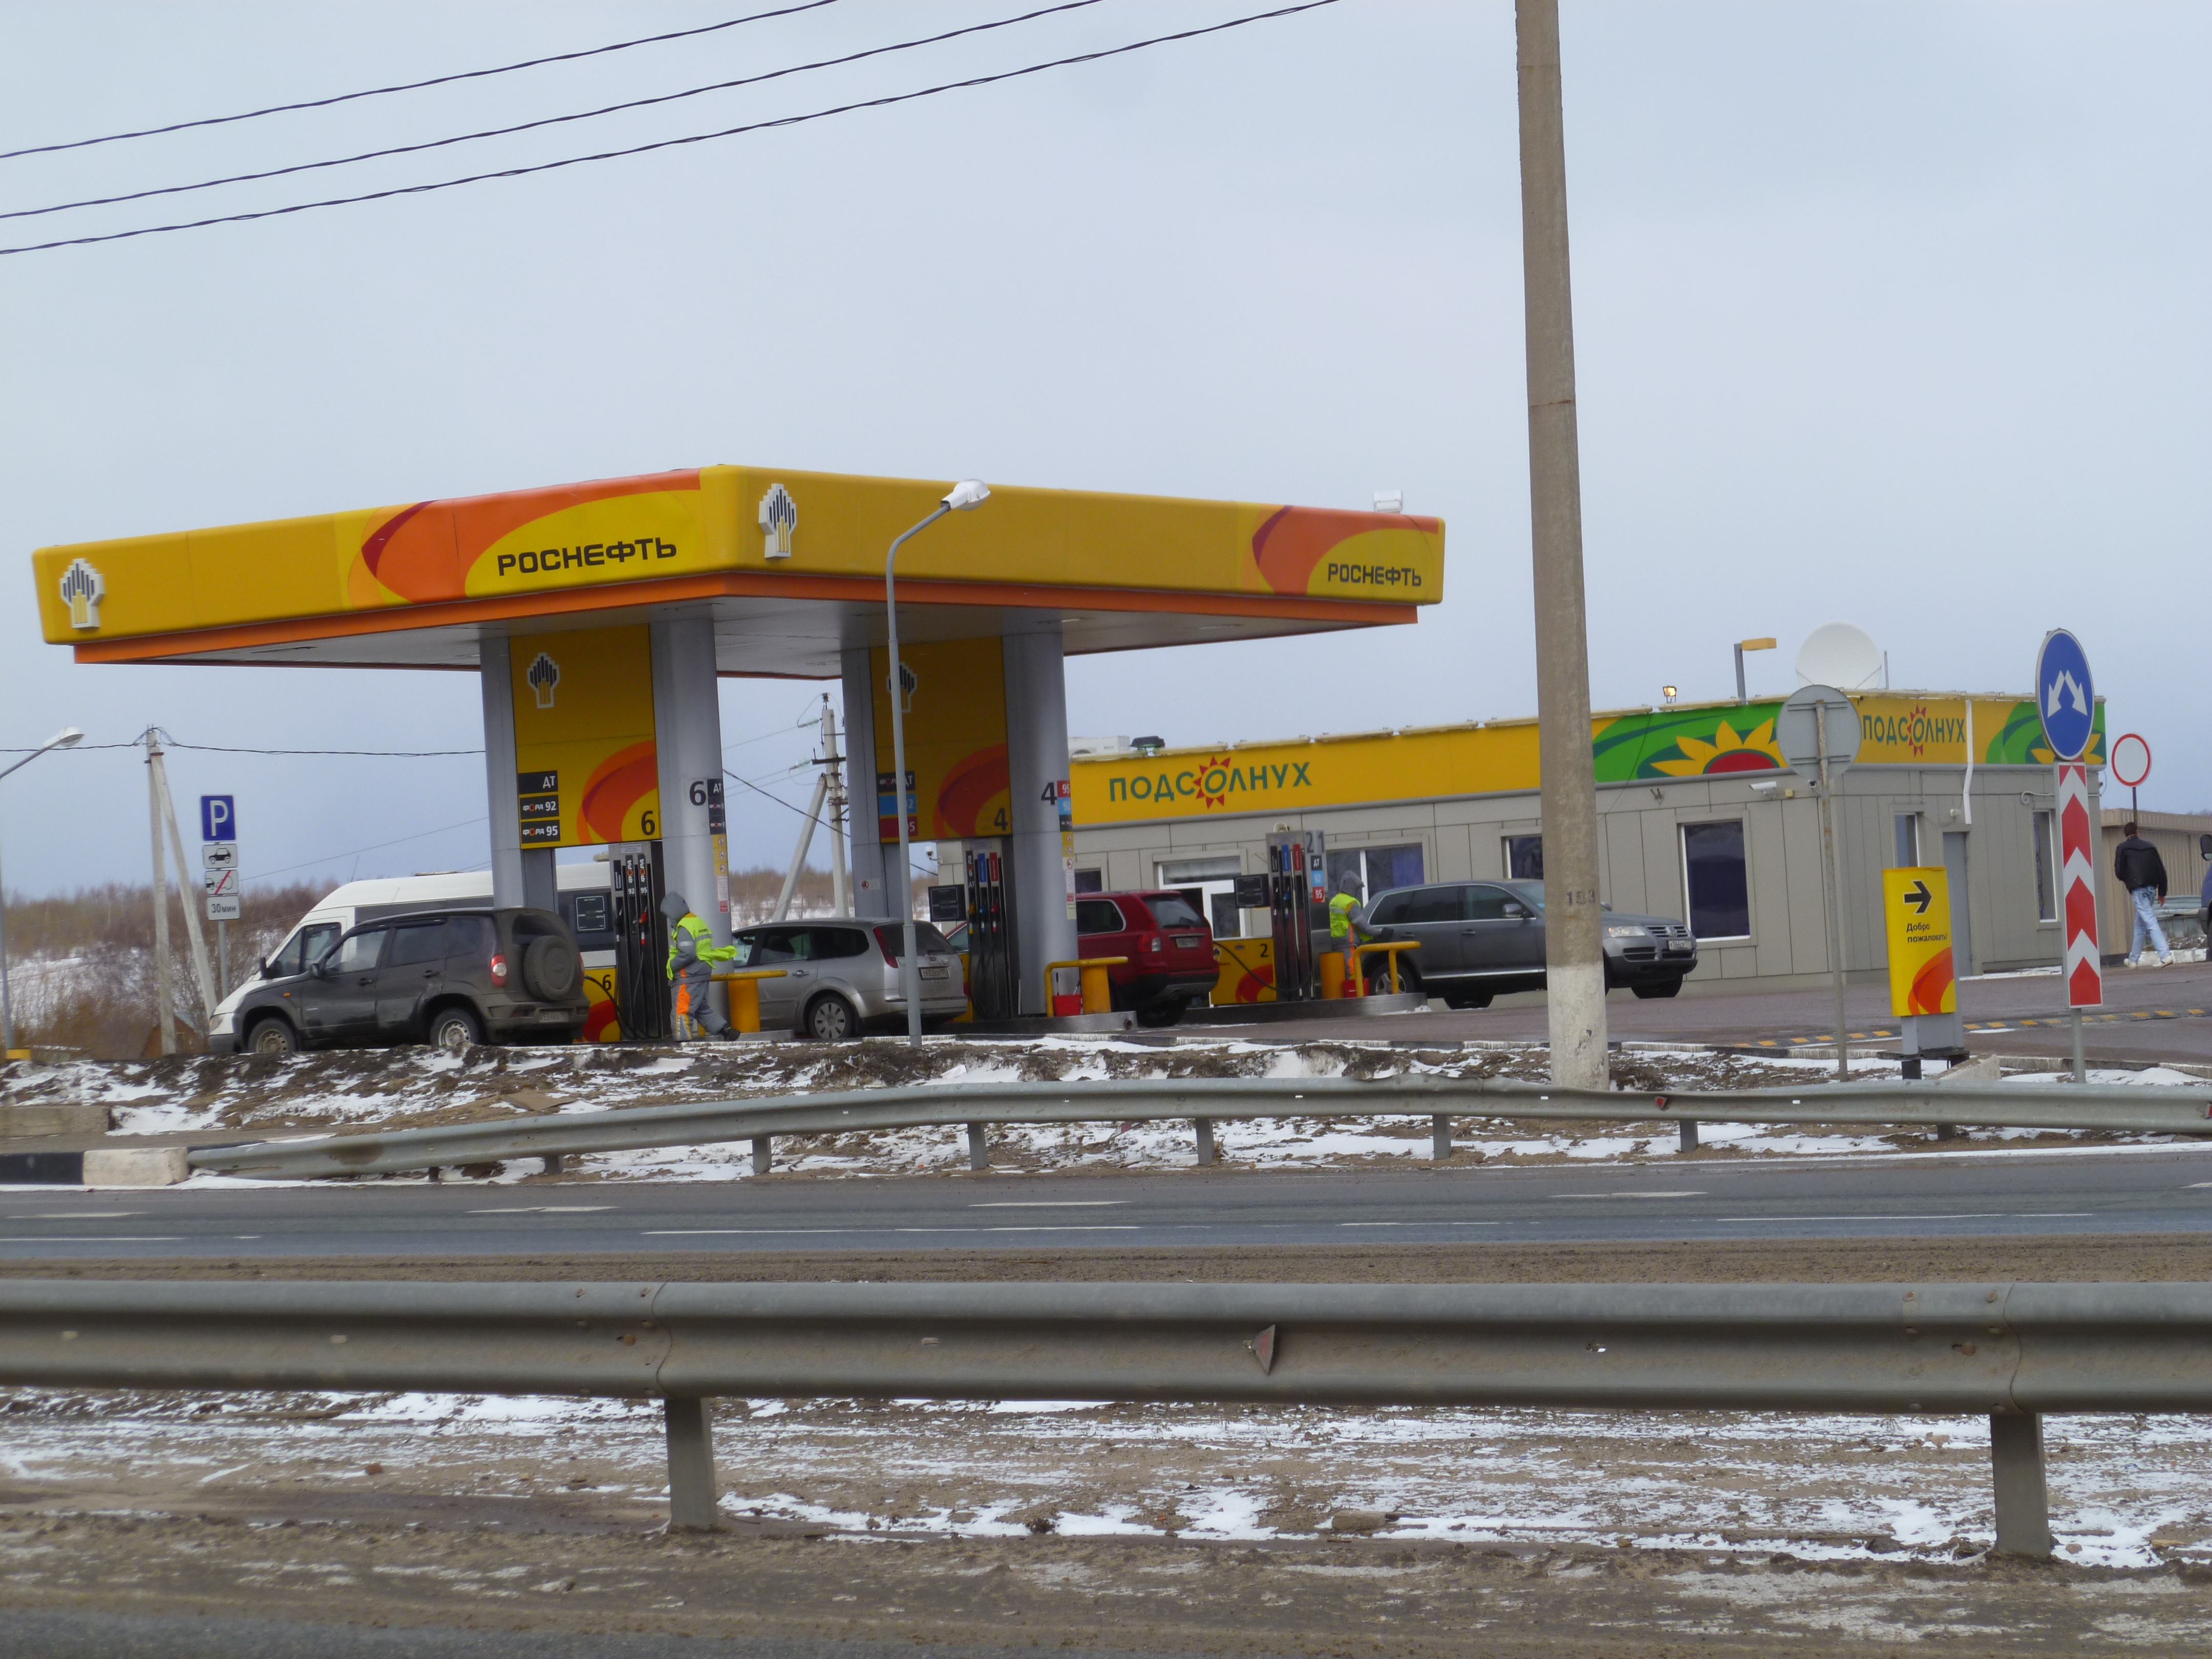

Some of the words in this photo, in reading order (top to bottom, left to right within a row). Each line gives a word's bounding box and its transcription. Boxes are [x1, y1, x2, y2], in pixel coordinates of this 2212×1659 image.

[497, 537, 677, 576] РОСНЕФТЬ
[1328, 563, 1422, 586] РОСНЕФТЬ
[1863, 715, 1966, 745] ПОДСОЛНУХ
[543, 775, 555, 789] ДТ
[879, 778, 897, 786] ФОР
[1062, 783, 1070, 794] 95
[1110, 761, 1312, 802] ПОДСОЛНУХ
[689, 780, 706, 806] 6
[1041, 782, 1057, 805] 4
[545, 801, 556, 812] 92
[210, 800, 228, 837] P
[641, 811, 655, 836] 6
[994, 807, 1008, 831] 4
[546, 825, 558, 836] 95
[1315, 890, 1322, 899] 95
[1906, 923, 1930, 932] Добро
[1907, 933, 1947, 943] пожаловать!
[1260, 944, 1268, 957] 2
[603, 974, 611, 990] 6
